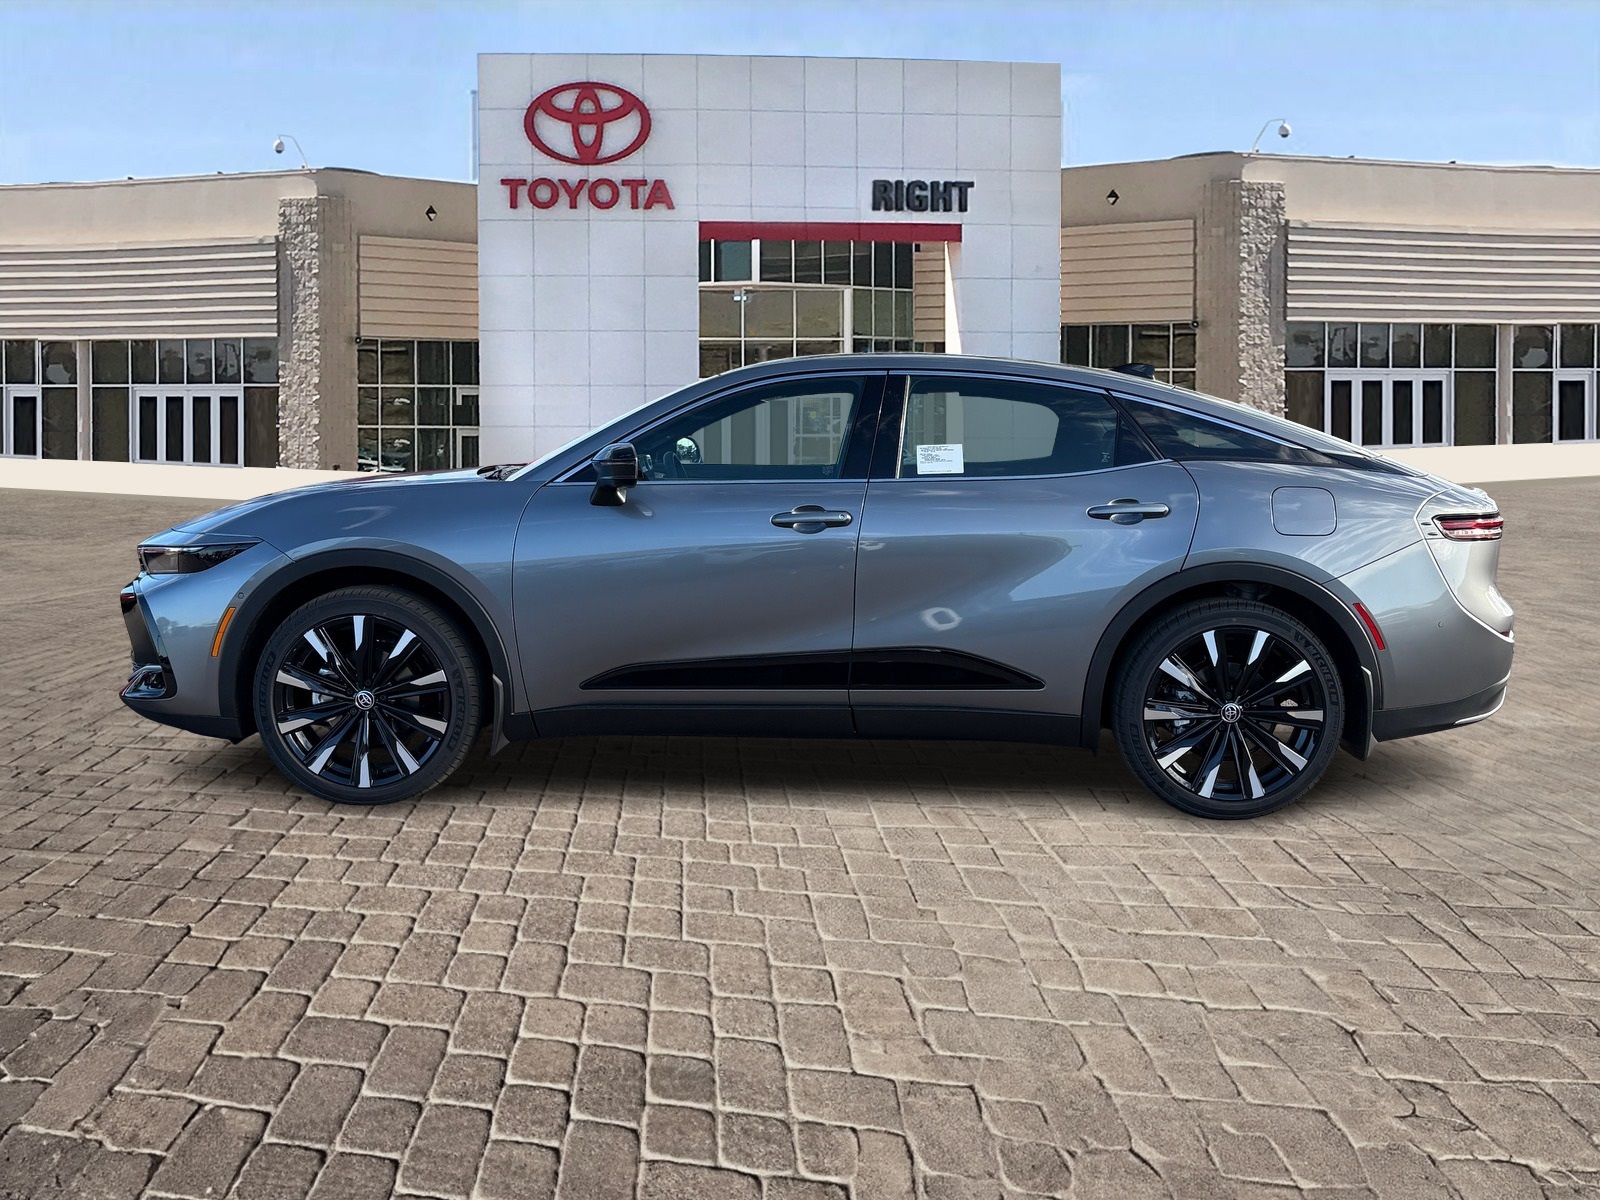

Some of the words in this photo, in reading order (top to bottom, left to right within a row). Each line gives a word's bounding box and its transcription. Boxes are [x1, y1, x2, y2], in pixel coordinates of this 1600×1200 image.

[502, 179, 674, 210] TOYOTA
[872, 180, 975, 213] RIGHT
[1309, 645, 1338, 703] MICHELIN
[448, 687, 465, 748] MICHELIN
